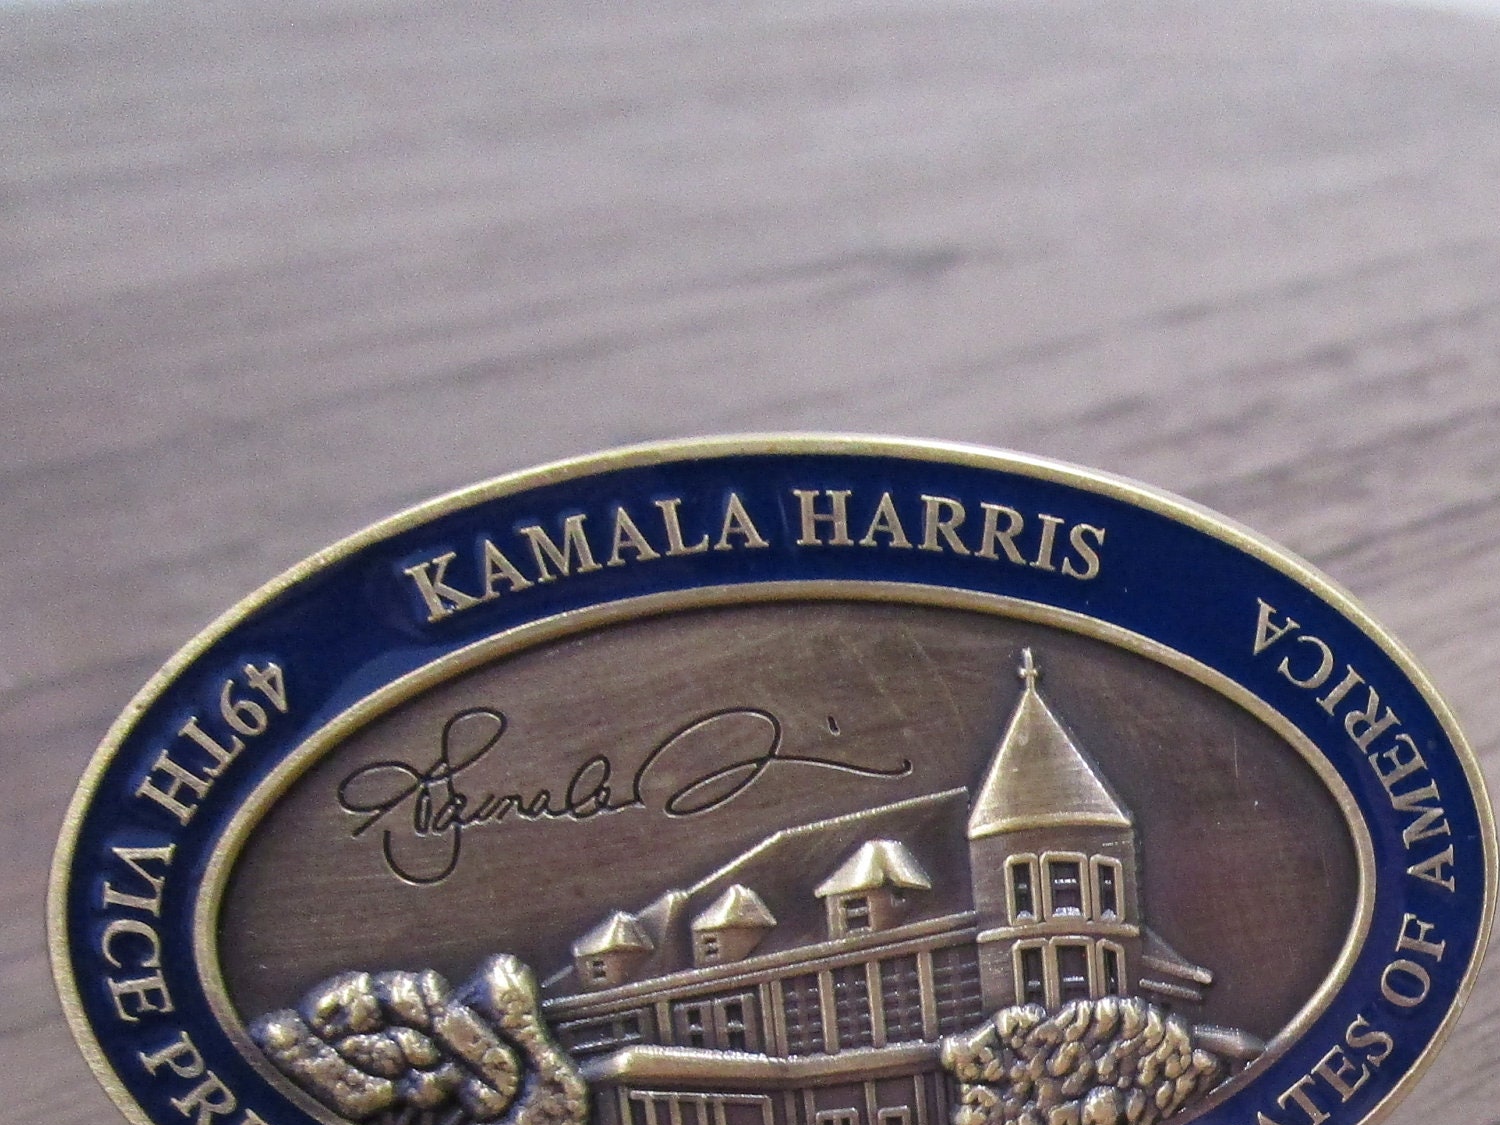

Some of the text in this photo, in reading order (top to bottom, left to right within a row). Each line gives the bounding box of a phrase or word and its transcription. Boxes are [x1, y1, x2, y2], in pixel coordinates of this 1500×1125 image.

[403, 488, 1106, 623] KAMALA HARRIS
[136, 660, 290, 825] 49TH
[1250, 597, 1457, 893] AMERICA
[101, 842, 176, 1022] VICE
[1379, 912, 1447, 1008] OF
